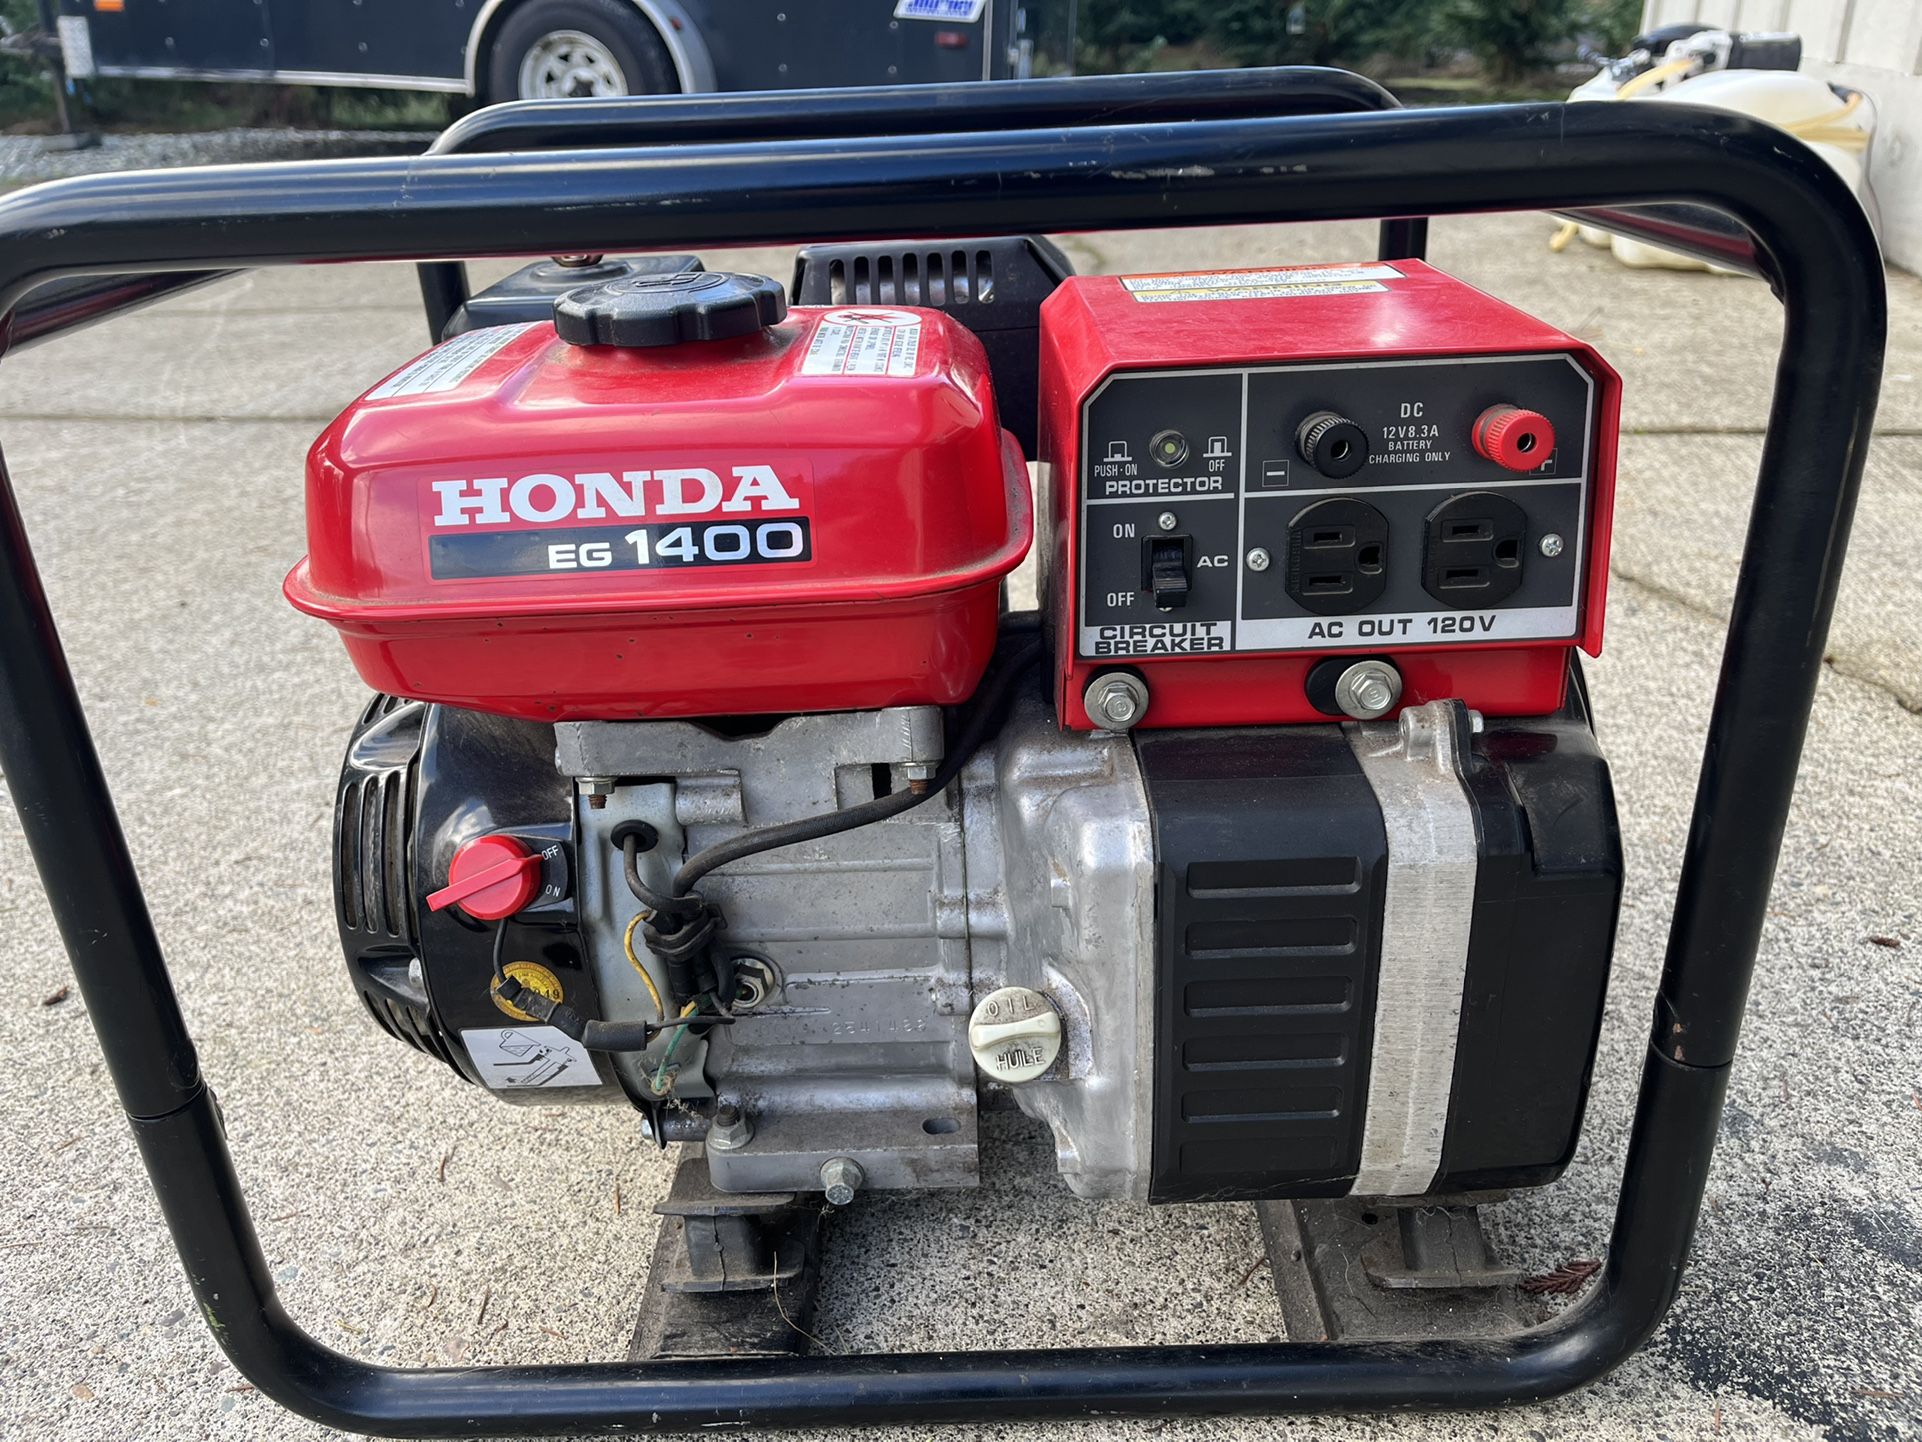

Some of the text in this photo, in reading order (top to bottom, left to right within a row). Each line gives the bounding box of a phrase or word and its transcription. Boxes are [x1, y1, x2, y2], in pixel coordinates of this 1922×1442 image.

[1400, 402, 1424, 418] DC
[1388, 440, 1433, 451] BATTERY
[1208, 459, 1226, 472] OFF
[1368, 451, 1451, 464] CHARGING ONLY
[1105, 476, 1223, 495] PROTECTOR
[431, 464, 800, 527] HONDA
[1112, 523, 1135, 539] ON
[547, 522, 804, 569] EG 1400
[1196, 555, 1229, 568] AC
[1106, 592, 1135, 607] OFF
[1099, 621, 1218, 641] CIRCUIT
[1308, 614, 1497, 639] AC OUT 120V
[1094, 636, 1224, 655] BREAKER
[541, 844, 560, 861] OFF
[545, 884, 561, 898] ON
[987, 995, 1035, 1018] OIL
[996, 1047, 1045, 1072] HUILE
